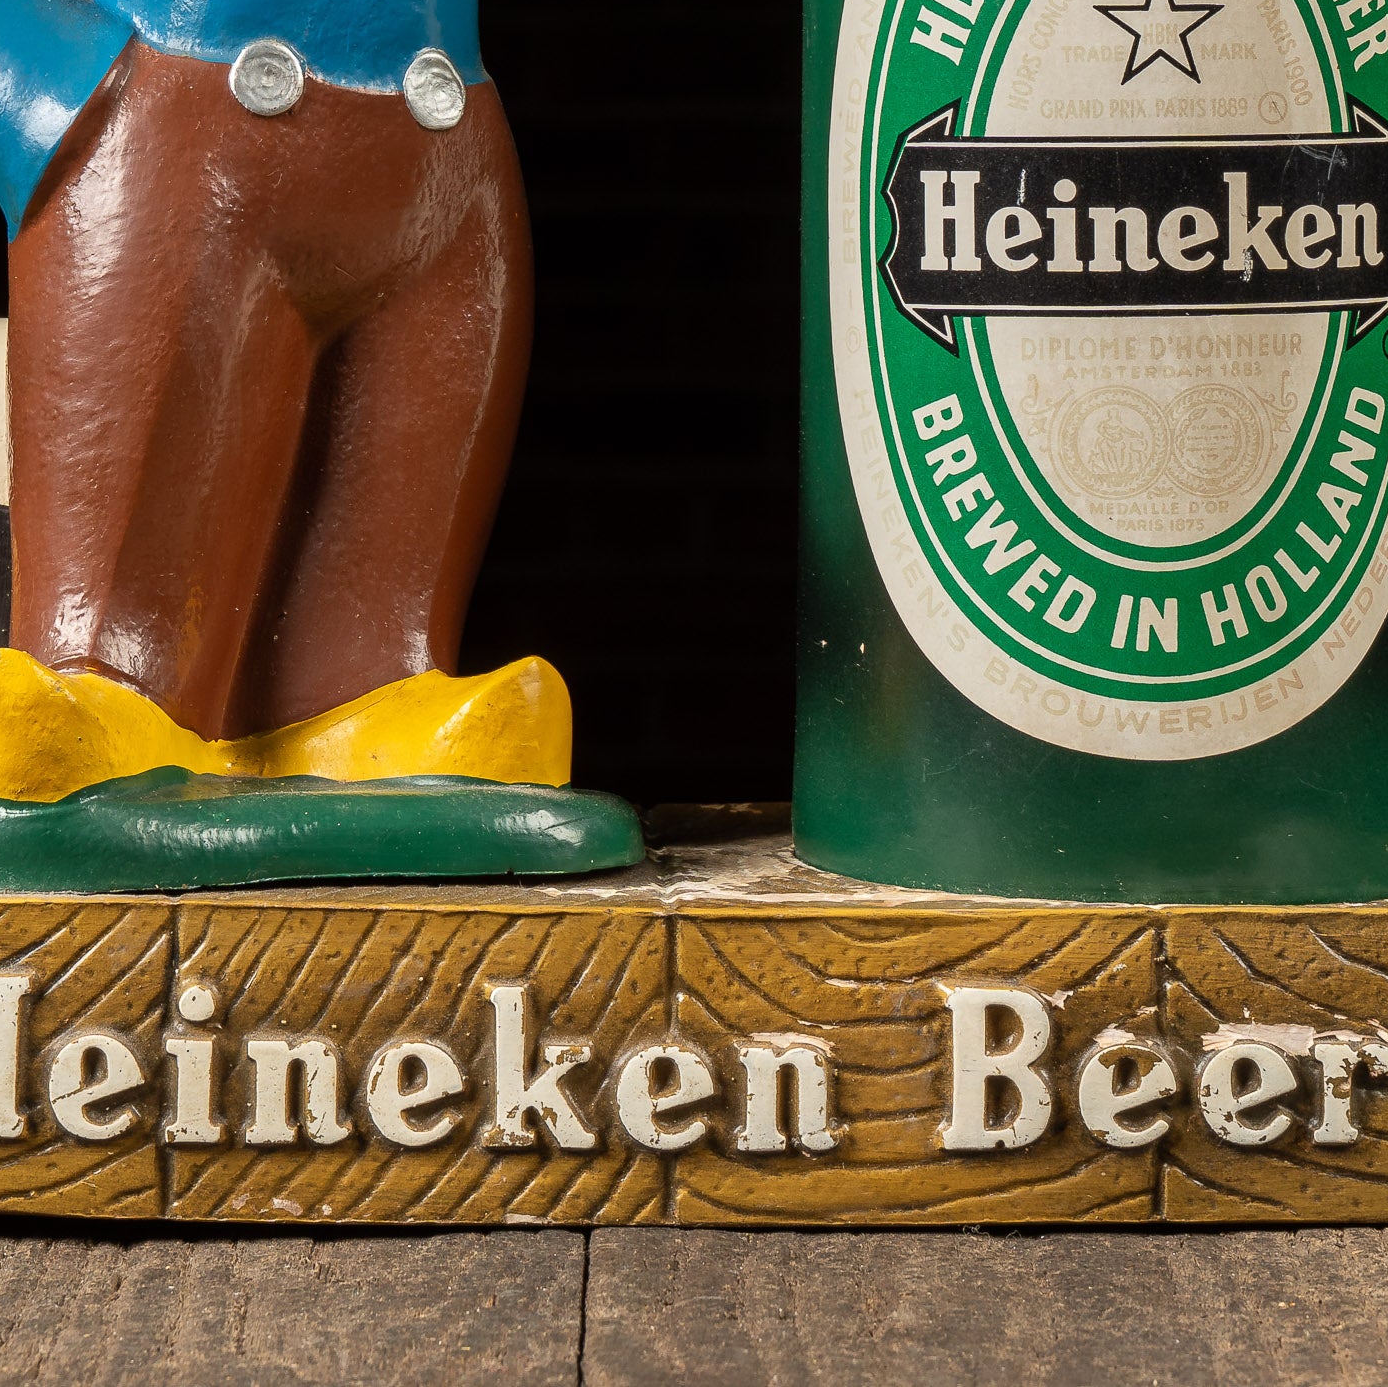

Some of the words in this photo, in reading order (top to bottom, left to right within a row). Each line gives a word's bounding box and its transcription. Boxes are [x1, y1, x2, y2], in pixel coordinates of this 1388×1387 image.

[1061, 44, 1127, 63] TRADE
[1200, 42, 1259, 62] MARK
[1007, 51, 1044, 111] HORS
[1282, 54, 1314, 108] 1900
[1039, 97, 1105, 120] GRAND
[1154, 97, 1206, 119] PARIS
[1210, 96, 1250, 118] 1889
[841, 77, 863, 265] BREWED
[919, 170, 1385, 274] Heineken
[1020, 335, 1137, 361] DIPLOME
[1149, 332, 1303, 360] D'HONNEUR
[1063, 363, 1213, 381] AMSTERDAM
[911, 392, 1098, 635] BREWED
[1110, 593, 1180, 654] IN
[1199, 386, 1388, 649] HOLLAND
[1189, 499, 1230, 515] D'OR
[1116, 518, 1163, 533] PARIS
[853, 387, 971, 653] HEINEKEN'S
[983, 654, 1305, 735] BROUWERIJEN
